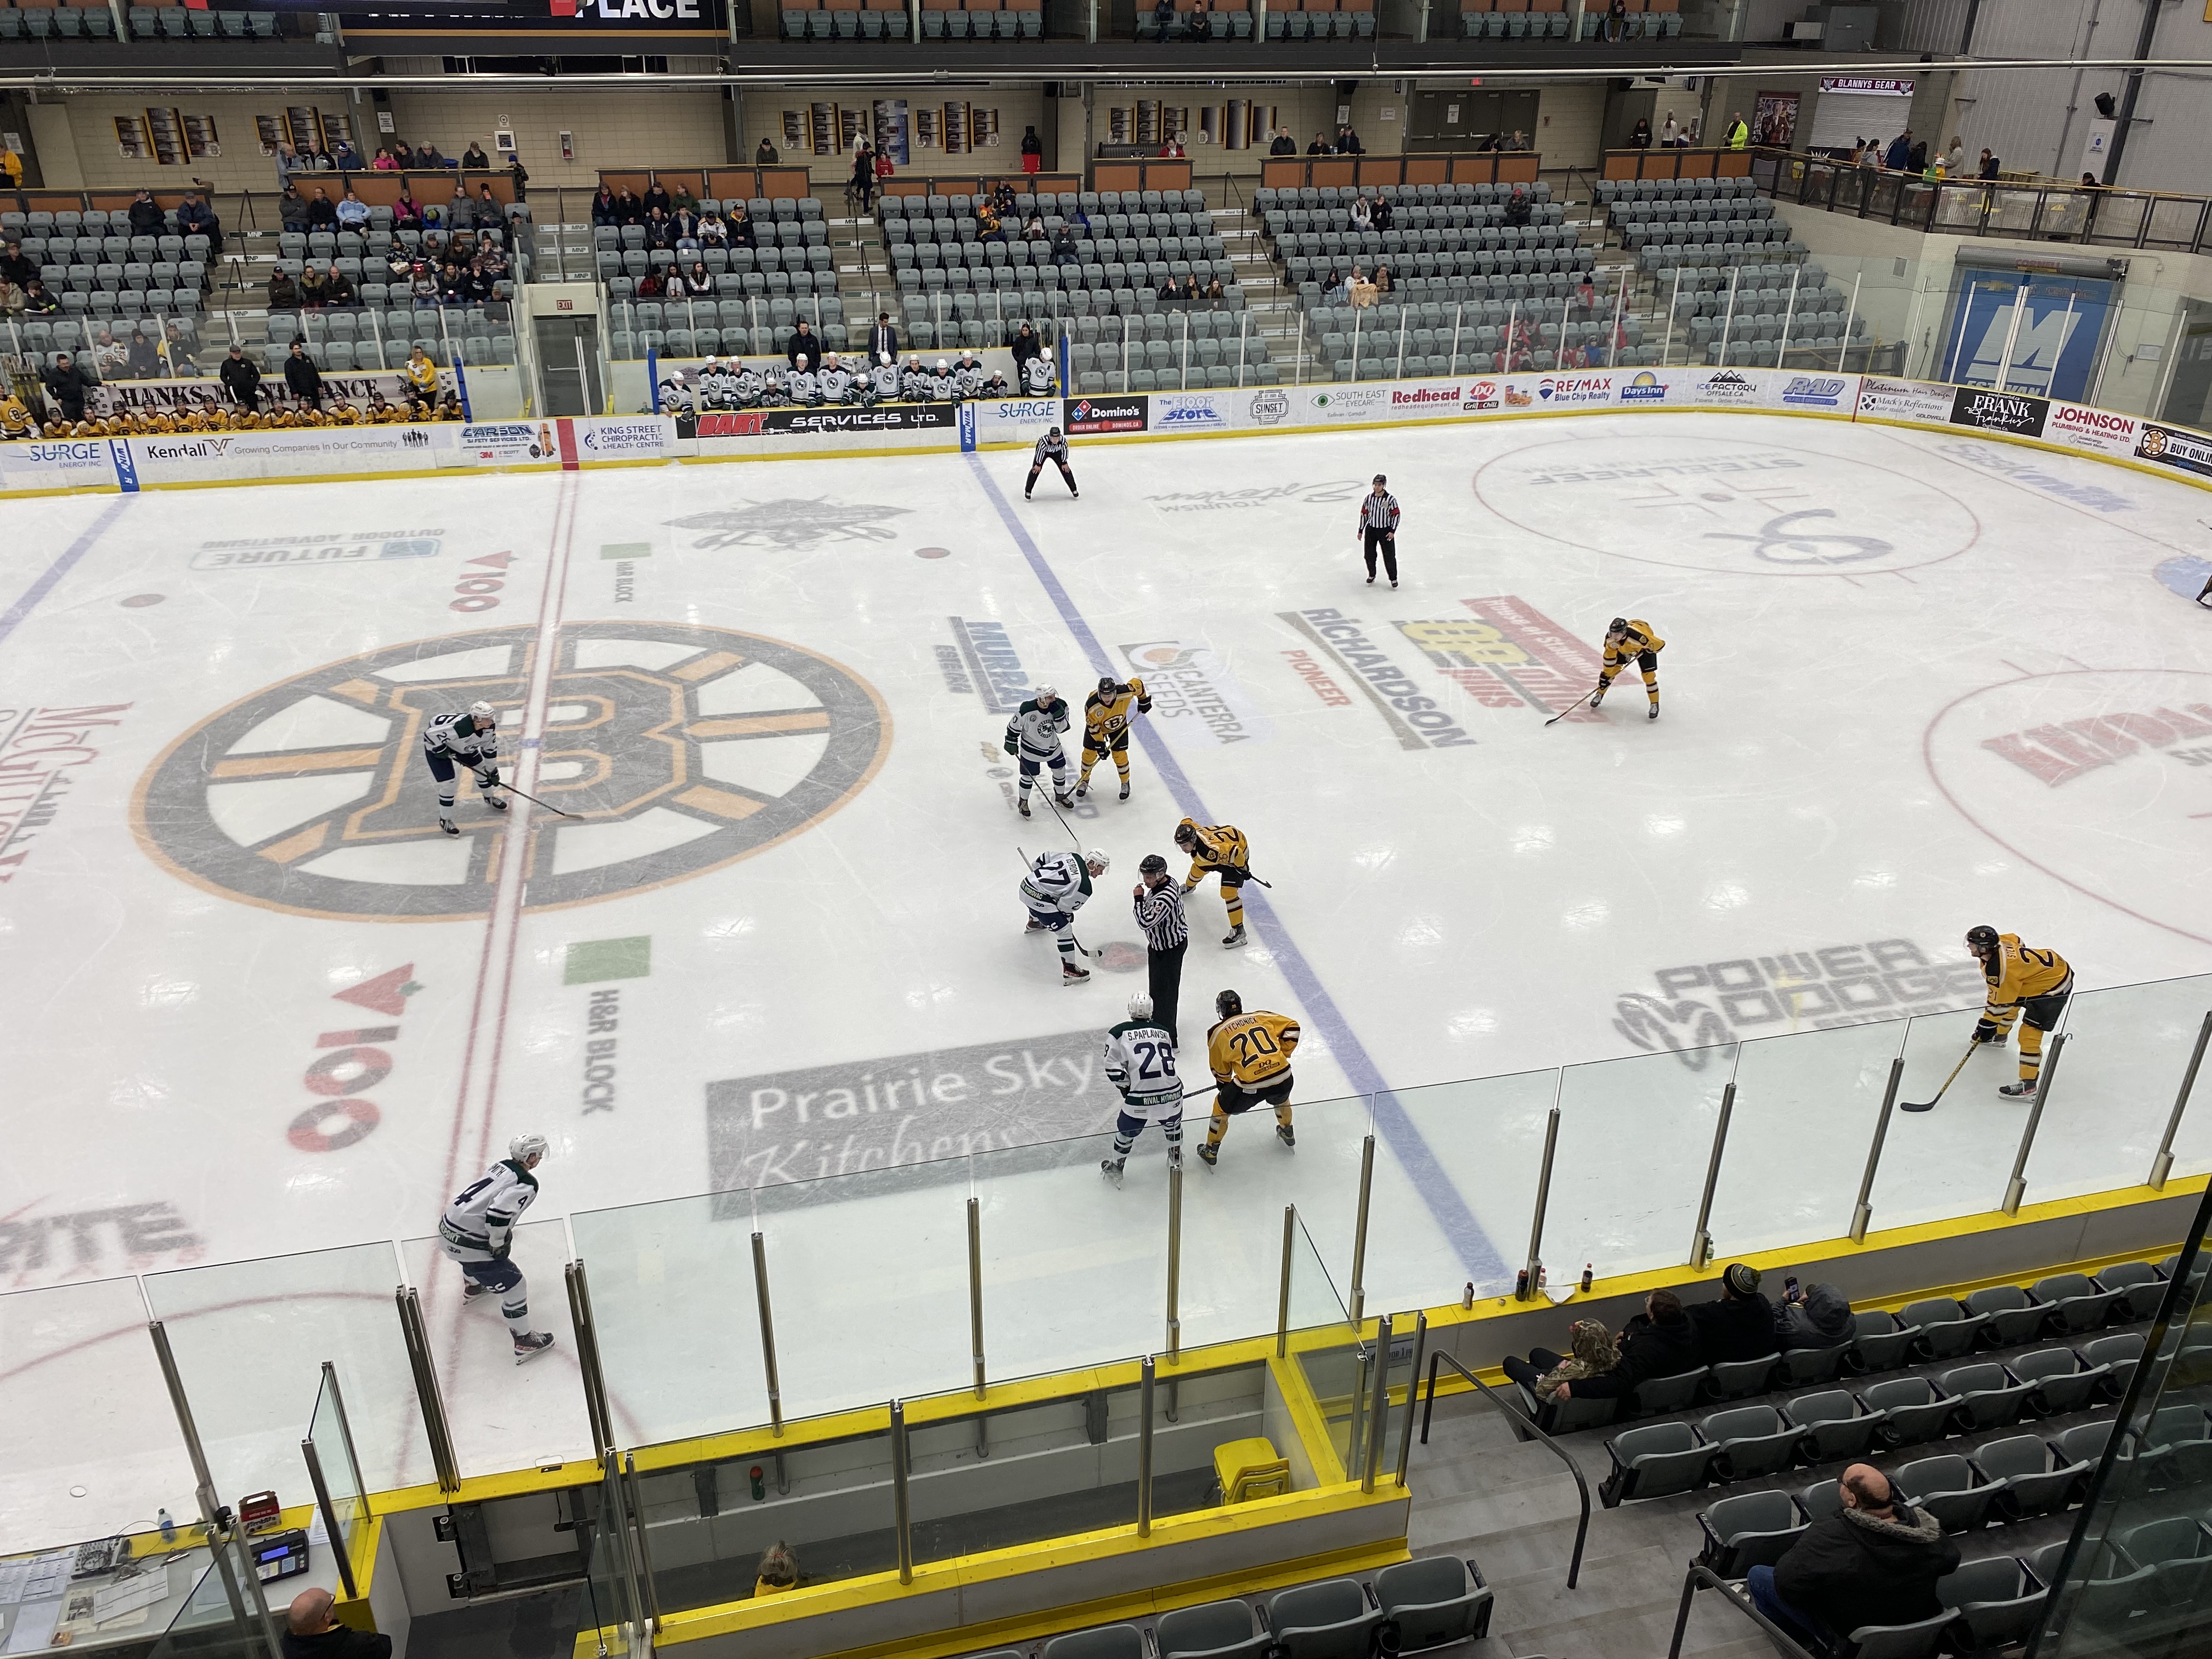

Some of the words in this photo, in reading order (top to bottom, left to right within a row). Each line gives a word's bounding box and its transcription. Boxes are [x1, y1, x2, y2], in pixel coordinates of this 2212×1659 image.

[1838, 79, 1872, 88] BLANNYS
[557, 301, 572, 309] EXIT
[1473, 385, 1494, 396] DQ
[1556, 378, 1612, 392] RE/MAX
[1624, 387, 1646, 396] Days
[1712, 384, 1756, 392] FACTORY
[1783, 377, 1845, 397] RAD
[1865, 379, 1910, 393] Platinum
[1912, 387, 1928, 396] Hair
[1930, 389, 1951, 398] Design
[1967, 380, 2041, 396] ESTVAN
[1335, 391, 1364, 400] SOUTH
[1365, 390, 1386, 399] EAST
[1392, 387, 1461, 404] Redhead
[1555, 392, 1570, 401] Blue
[1572, 392, 1587, 401] Chip
[1588, 391, 1610, 400] Realty
[998, 401, 1056, 418] SURGE
[1092, 406, 1139, 418] Domino's
[1256, 403, 1284, 414] SUNSET
[1877, 397, 1903, 407] Mack's
[1904, 397, 1943, 411] Reflections
[1974, 394, 2031, 417] FRANK
[697, 413, 768, 436] DART
[790, 413, 901, 427] SERVICES
[911, 414, 939, 422] LTD.
[1916, 413, 1947, 421] GOLDWELL
[2055, 407, 2134, 434] JOHNSON
[461, 425, 535, 437] CARSON
[627, 425, 662, 434] STREET
[963, 410, 972, 444] WINMAR
[2052, 422, 2083, 432] PLUMBING
[2092, 430, 2118, 441] HEATING
[602, 433, 663, 443] CHIROPRACTIC
[2148, 432, 2162, 452] B
[30, 443, 100, 461] SURGE
[148, 444, 206, 459] Kendall
[234, 445, 270, 455] Growing
[273, 443, 320, 454] Companies
[333, 442, 348, 450] Our
[2170, 443, 2187, 456] BUY
[1160, 501, 1265, 512] TOURISM
[202, 534, 344, 549] ADVERTISING
[352, 528, 445, 540] OUTDOOR
[211, 546, 368, 566] FUTURE
[616, 561, 634, 576] H&R
[449, 572, 506, 612] 100
[615, 578, 633, 603] BLOCK
[965, 622, 1037, 713] MURRA
[1280, 649, 1352, 706] PIONEER
[1139, 673, 1193, 718] SEEDS
[1173, 670, 1250, 744] CANTERRA
[1033, 860, 1071, 885] 27
[1654, 938, 1929, 1002] POWER
[1717, 961, 1982, 1025] DODGE
[588, 989, 619, 1035] H&R
[1224, 1017, 1258, 1035] TYCHONICK
[1229, 1026, 1278, 1068] 20
[1133, 1042, 1175, 1080] 28
[582, 1039, 618, 1116] BLOCK
[287, 1025, 400, 1153] 100
[750, 1067, 967, 1129] Prairie
[985, 1050, 1094, 1096] Sky
[1143, 1096, 1160, 1105] RIVAL
[454, 1177, 494, 1206] 4
[518, 1195, 528, 1209] 4
[440, 1222, 460, 1243] REPORT
